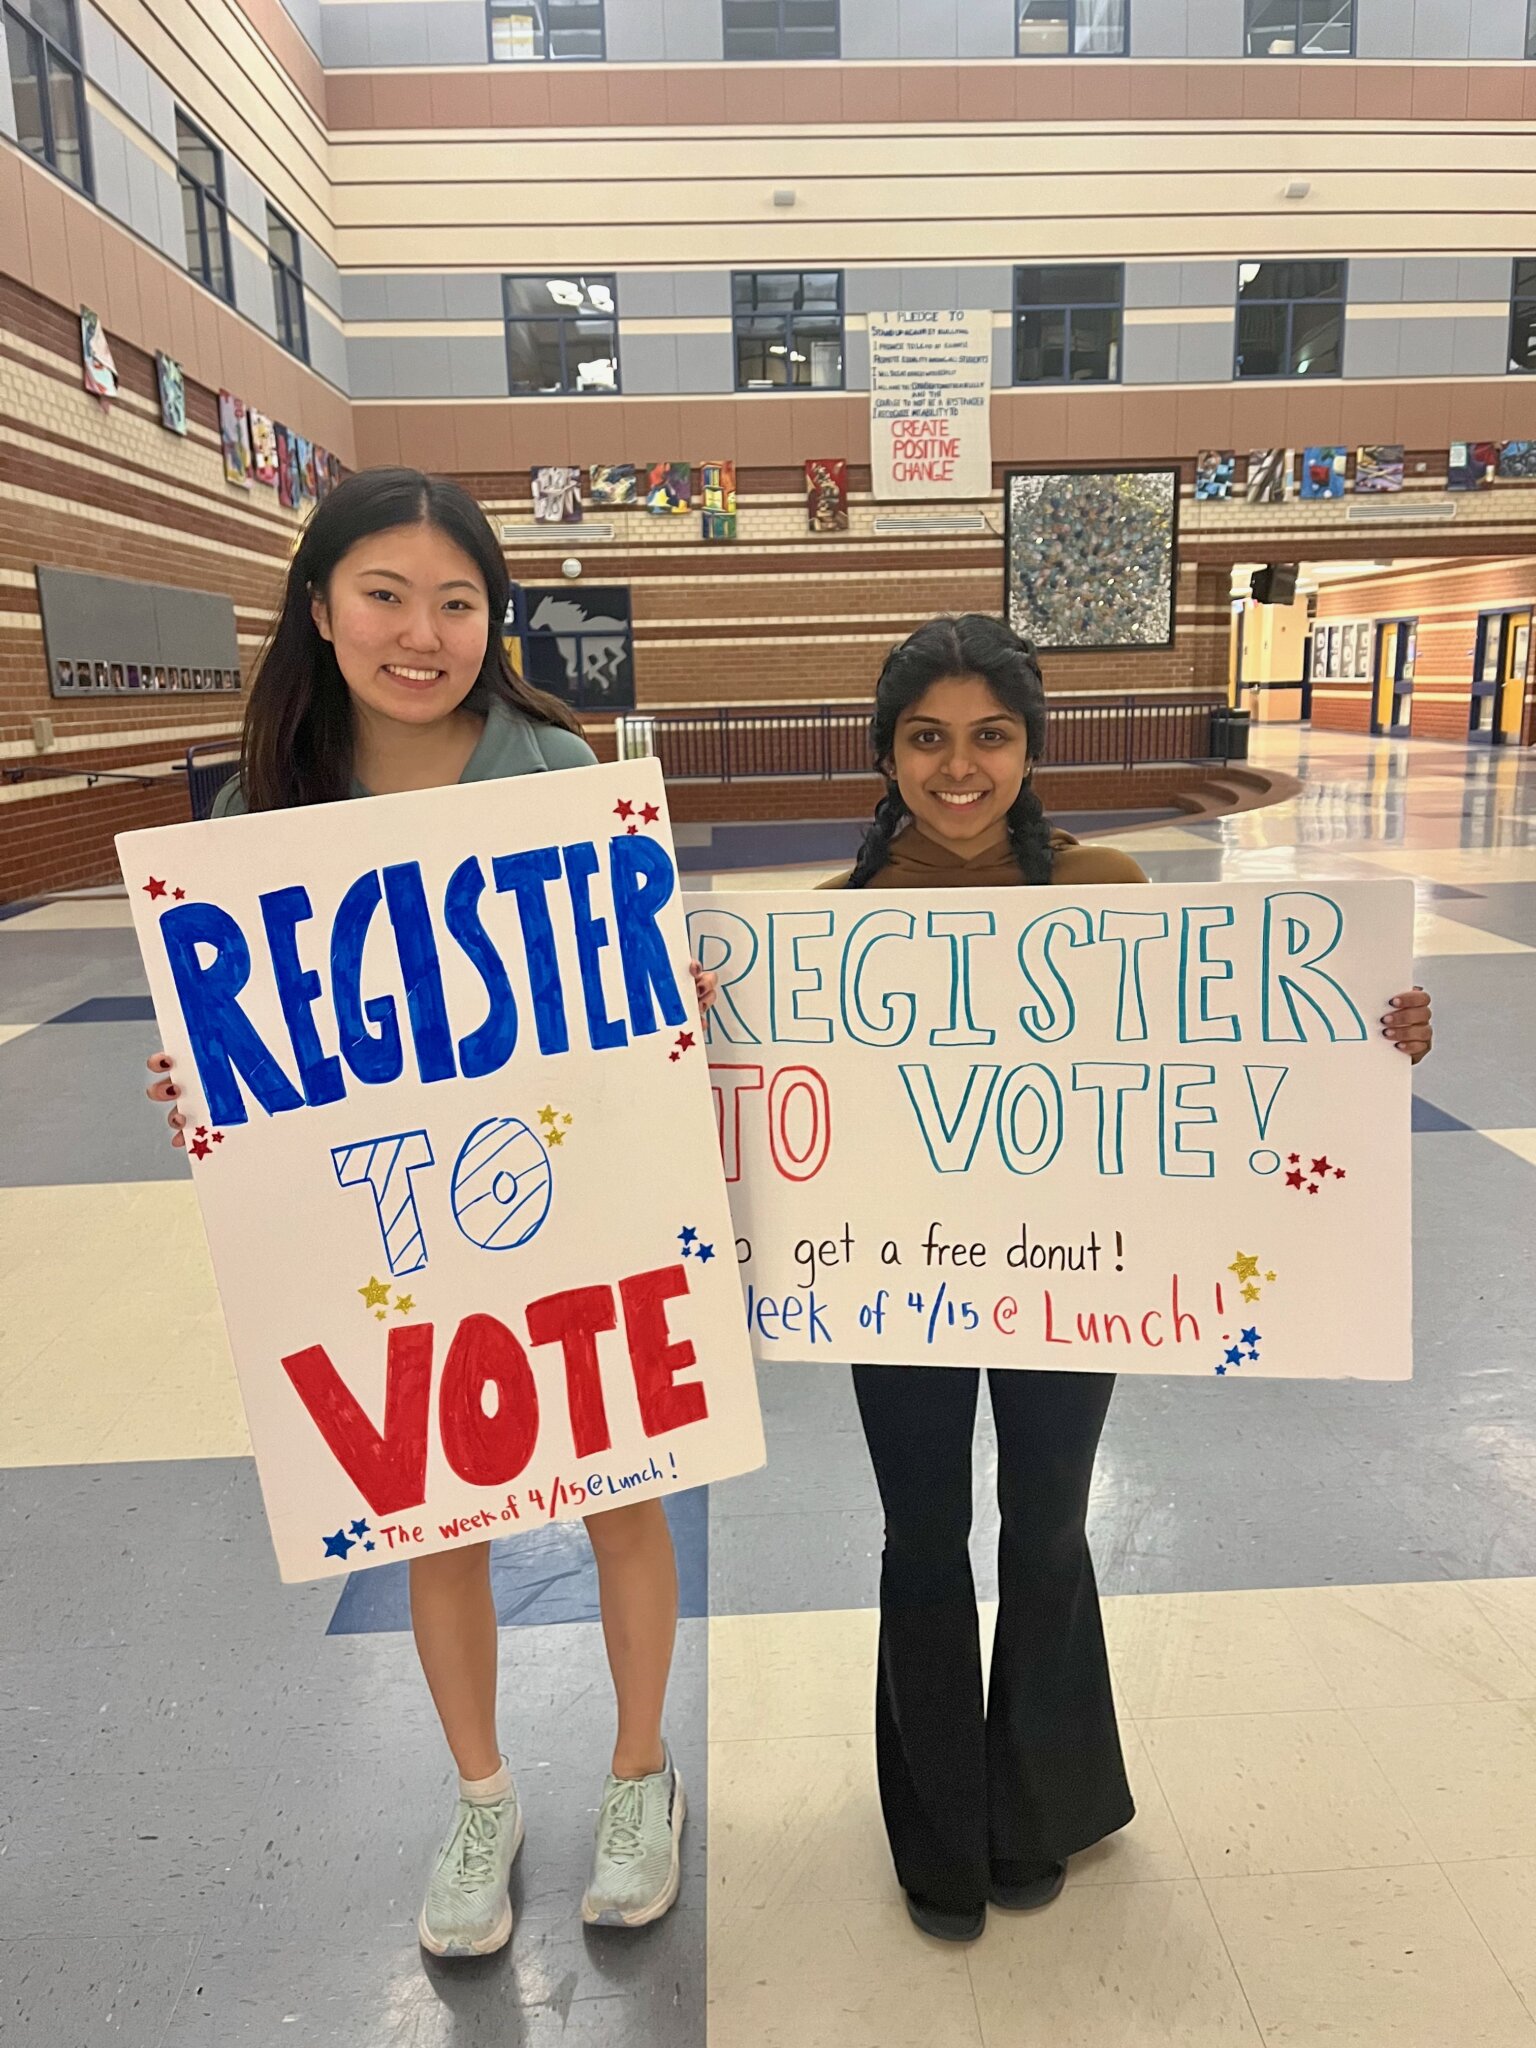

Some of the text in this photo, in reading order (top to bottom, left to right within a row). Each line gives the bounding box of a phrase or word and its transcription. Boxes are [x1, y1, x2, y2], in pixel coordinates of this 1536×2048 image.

[884, 311, 964, 323] I PLEDGE TO
[959, 355, 988, 363] STUDENTS
[875, 399, 900, 407] COURAGE
[946, 397, 984, 406] BYSTANDER
[951, 407, 958, 416] TO
[891, 419, 950, 437] CREATE
[893, 438, 961, 459] POSITIVE
[892, 460, 955, 482] CHANGE
[159, 834, 688, 1127] REGISTER
[686, 892, 1368, 1047] REGISTER
[330, 1116, 552, 1277] TO
[794, 1222, 855, 1288] get
[881, 1240, 902, 1265] a
[922, 1222, 986, 1266] free
[1006, 1222, 1124, 1272] donut!
[747, 1273, 1231, 1347] eek of 4/15 @ Lunch!
[281, 1264, 708, 1516] VOTE
[380, 1524, 424, 1549] The
[501, 1494, 520, 1521] of
